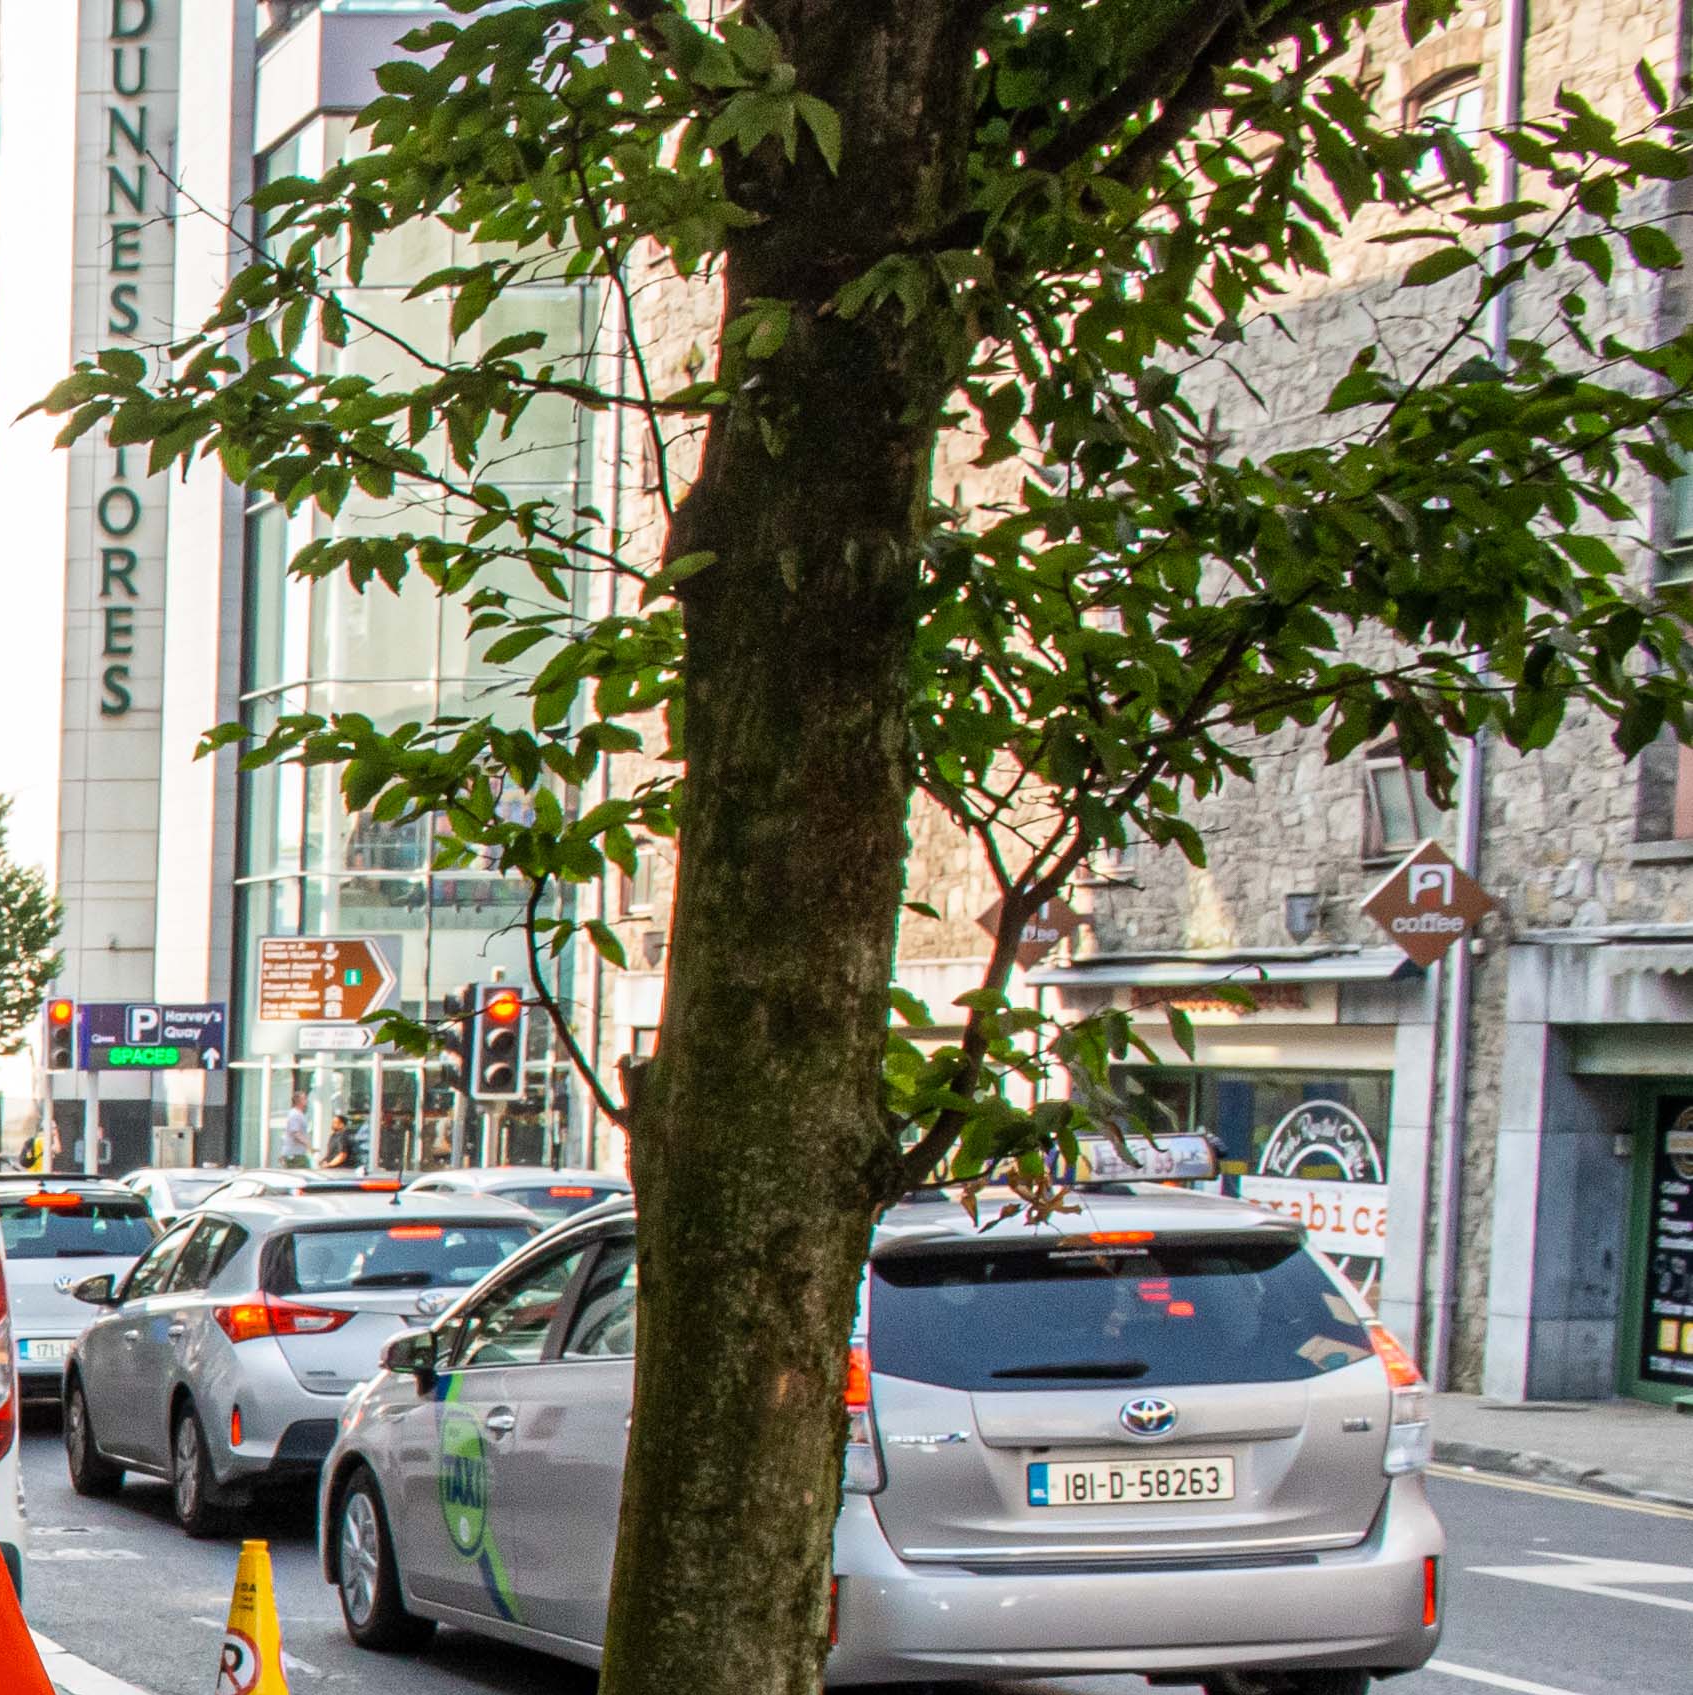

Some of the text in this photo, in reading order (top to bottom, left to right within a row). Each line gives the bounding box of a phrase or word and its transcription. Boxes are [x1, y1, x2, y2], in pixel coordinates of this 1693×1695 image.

[106, 0, 153, 338] DUNNES
[1391, 914, 1466, 934] coffee
[132, 1009, 158, 1042] P
[165, 1009, 223, 1025] Harvey's
[165, 1026, 203, 1041] Quay
[109, 1047, 180, 1066] SPACES
[1065, 1466, 1220, 1502] 181-D-58263
